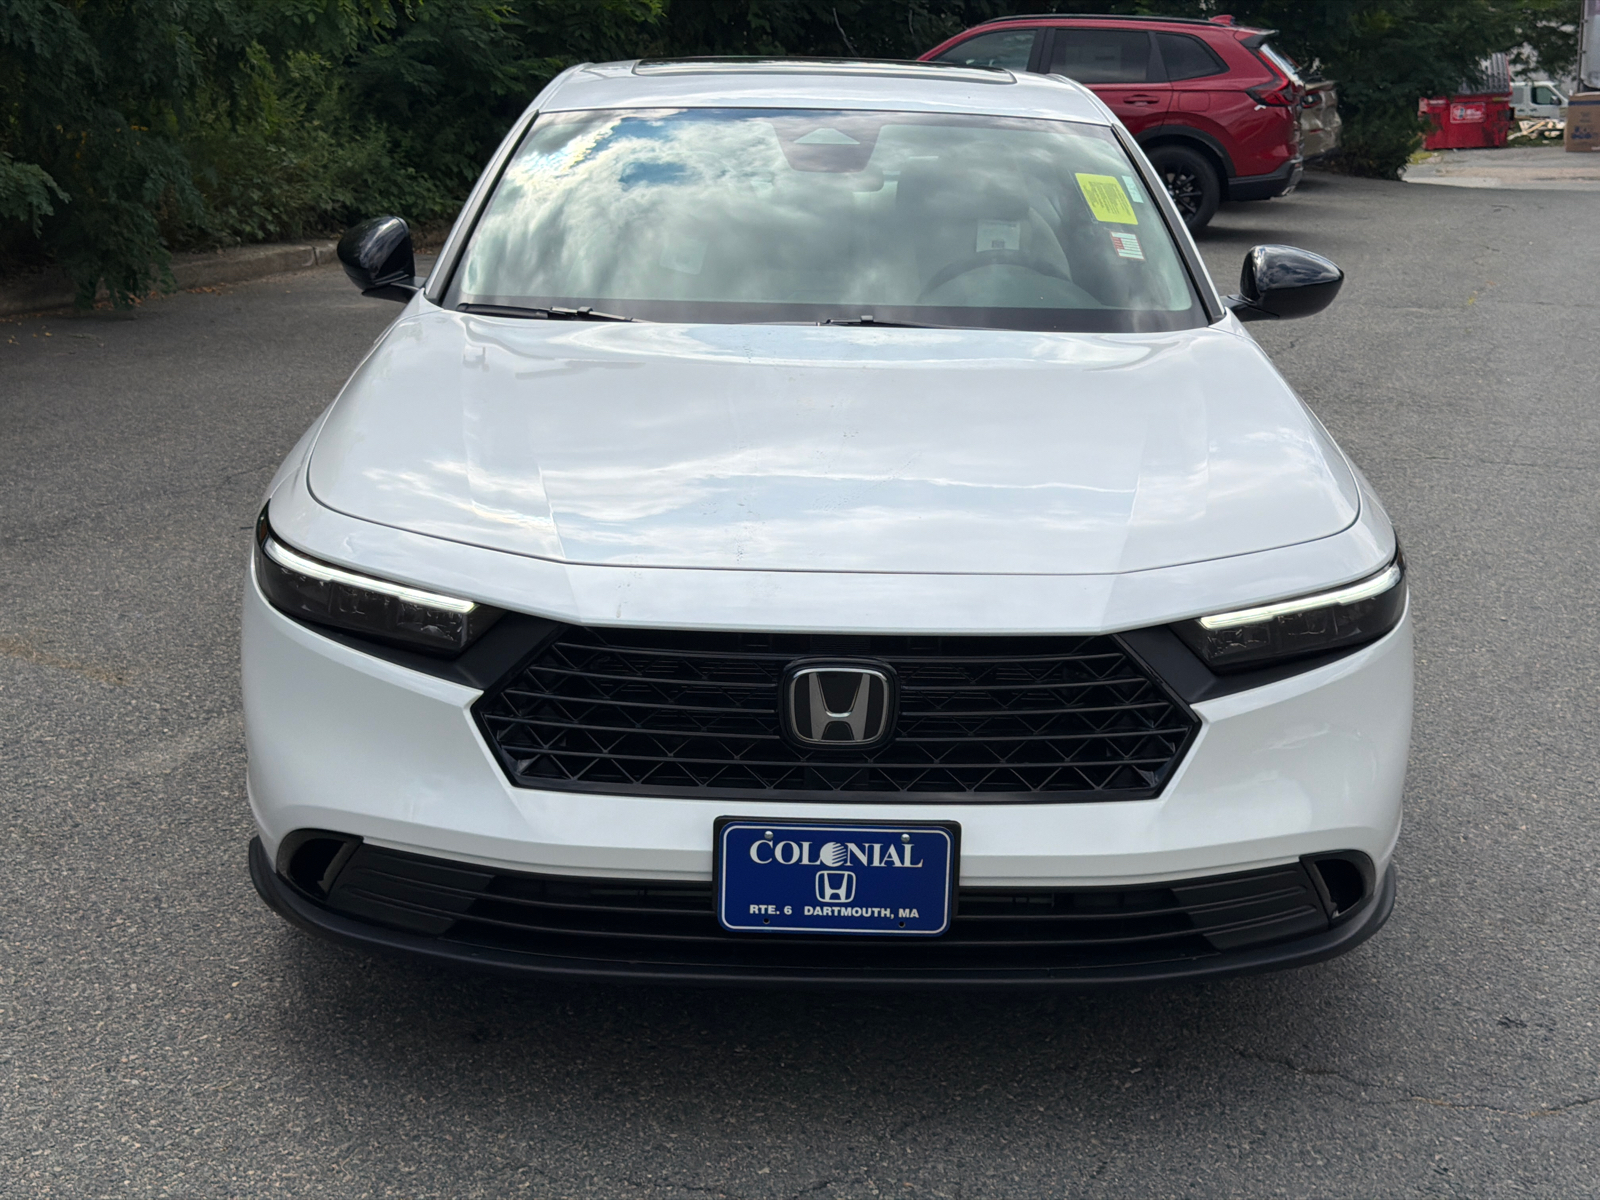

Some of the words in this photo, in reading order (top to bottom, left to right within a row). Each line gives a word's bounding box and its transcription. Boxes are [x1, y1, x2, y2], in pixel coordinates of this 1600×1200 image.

[750, 840, 924, 868] COLONIAL
[749, 904, 780, 915] RTE.
[784, 905, 793, 915] 6
[804, 905, 894, 919] DARTMOUTH,
[898, 908, 920, 918] MA
